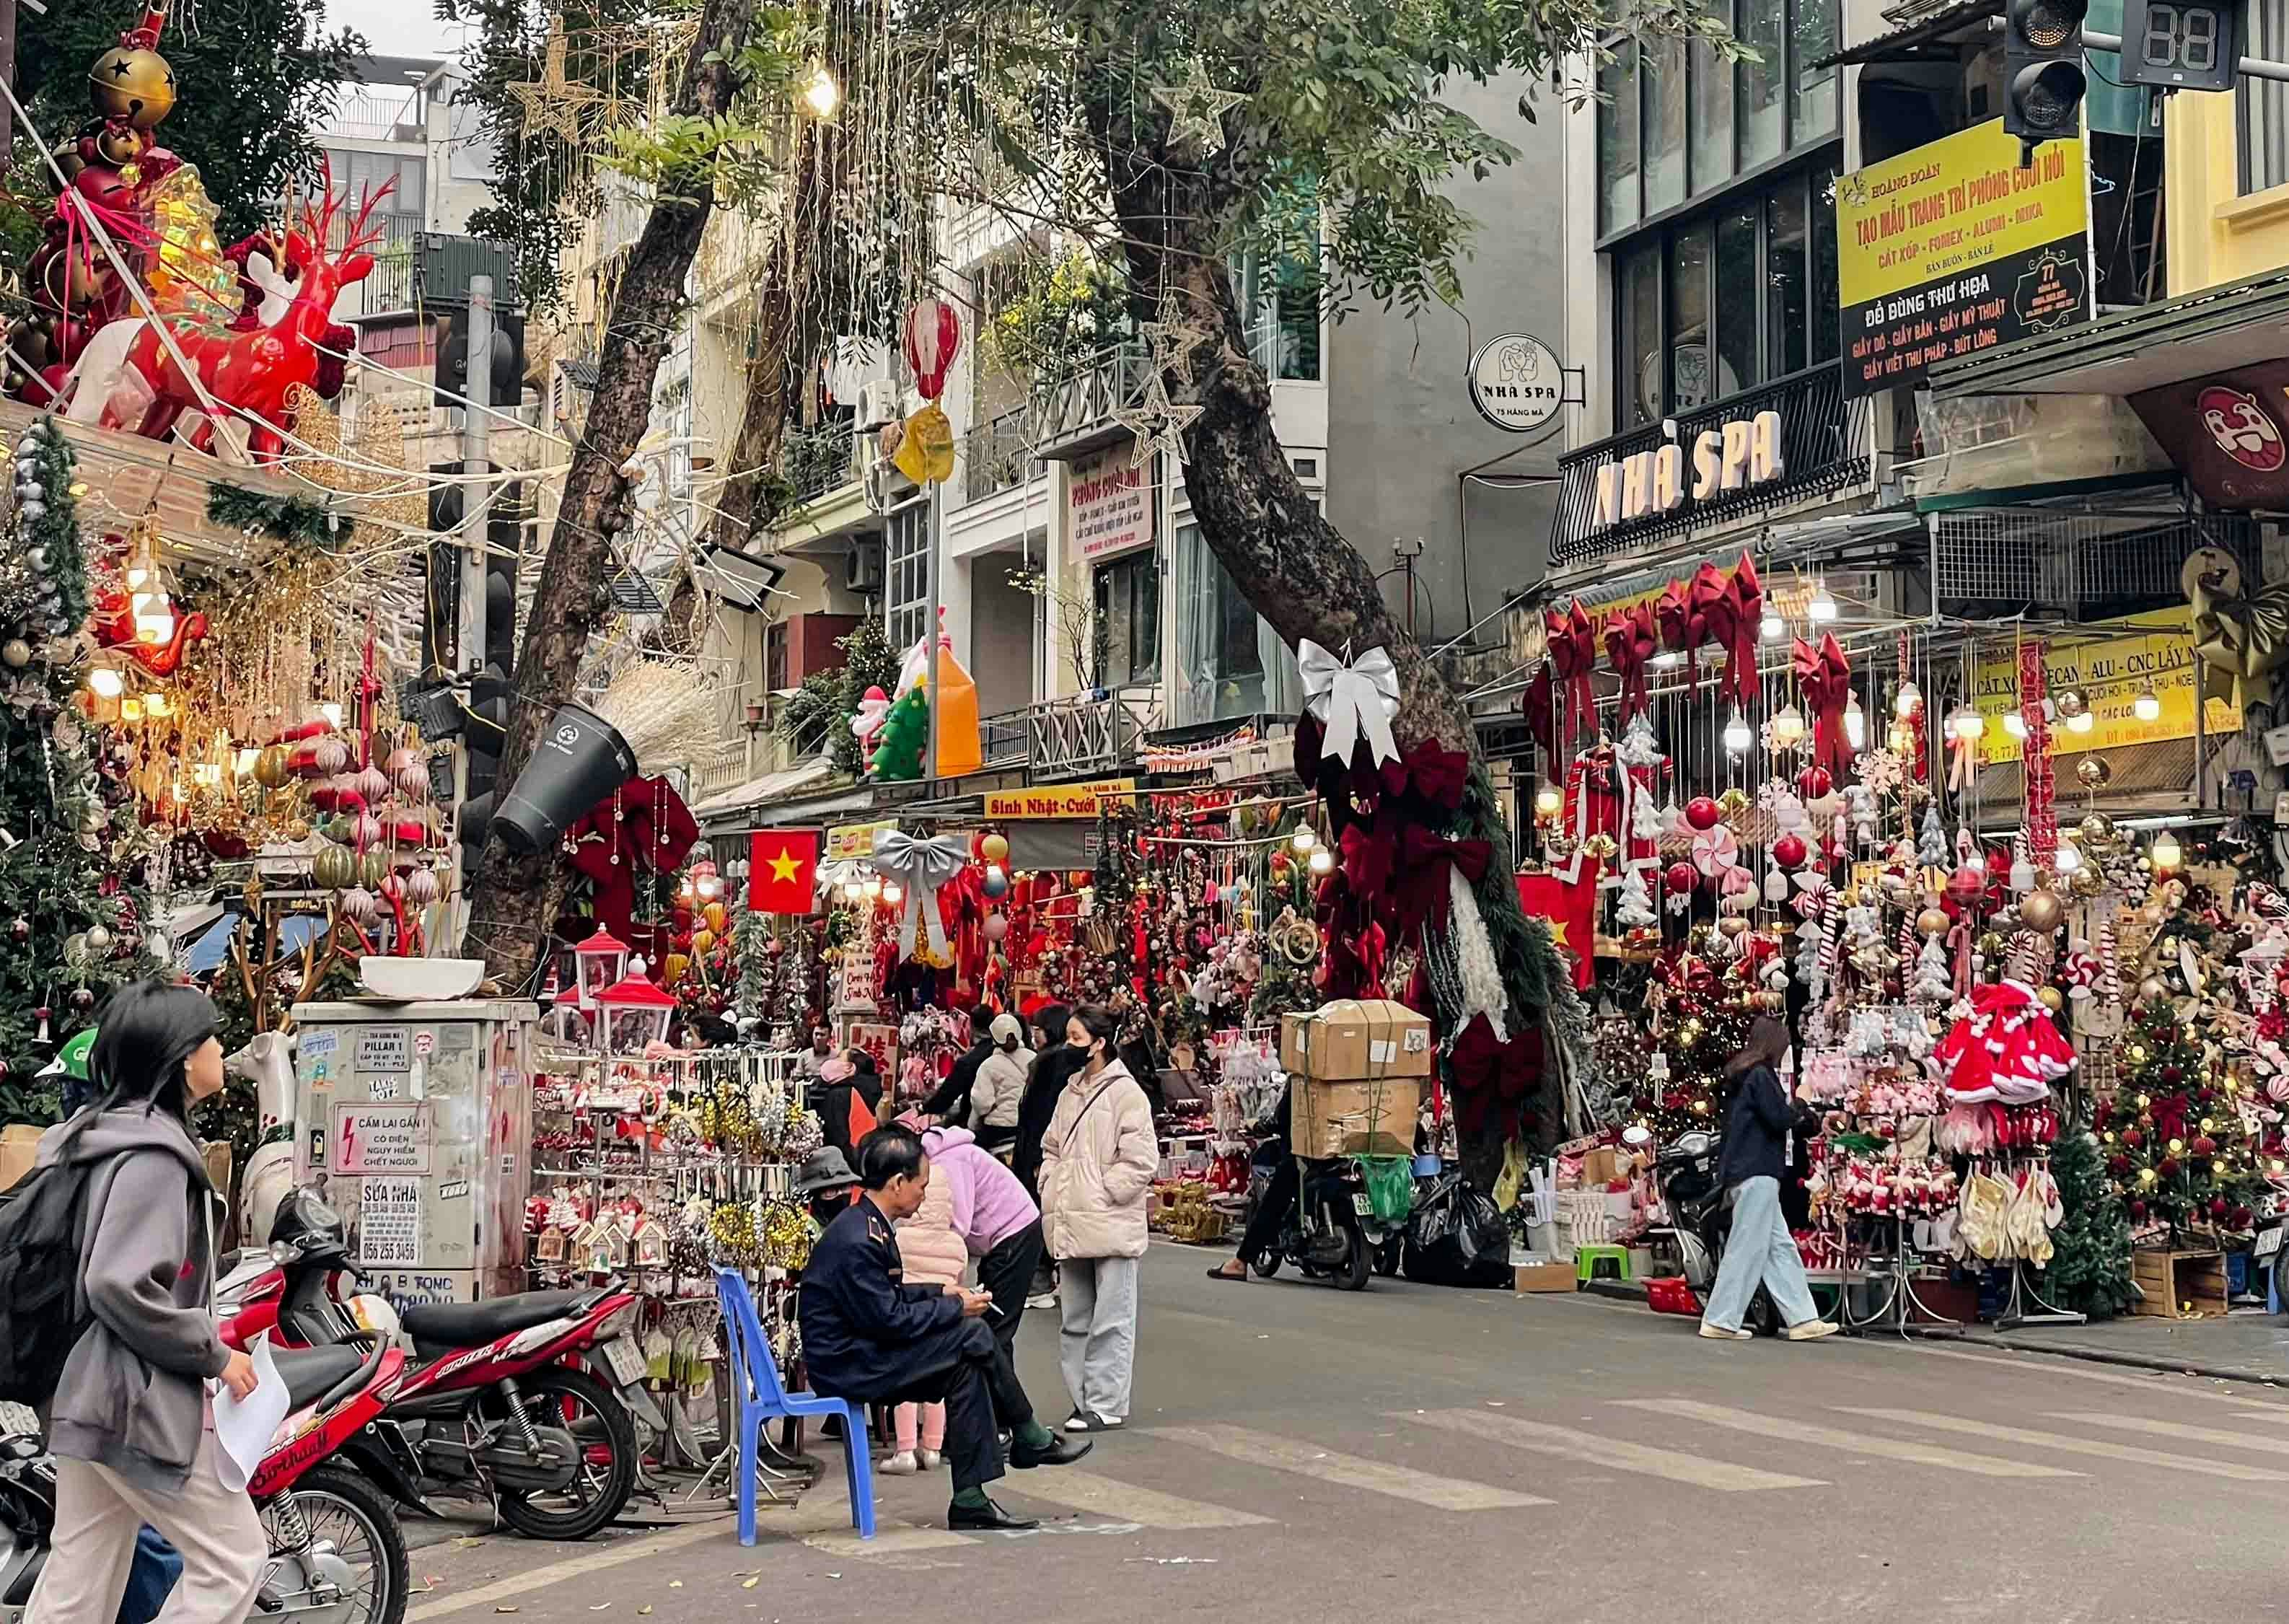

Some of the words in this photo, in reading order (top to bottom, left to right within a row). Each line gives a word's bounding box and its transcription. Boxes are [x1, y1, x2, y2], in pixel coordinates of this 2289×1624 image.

[1856, 215, 1877, 251] TẠO
[1880, 198, 1905, 239] MẪU
[1907, 191, 1946, 229] TRANG
[1948, 178, 1967, 215] TRÍ
[2042, 263, 2055, 282] 77
[1865, 300, 1885, 327] ĐỒ
[1928, 281, 1956, 308] THƯ
[1979, 298, 2006, 321] THUẬT
[1483, 382, 1519, 398] NHÀ
[1524, 387, 1555, 398] SPA
[1594, 418, 1684, 527] NHÀ
[1692, 411, 1783, 500] SPA
[2092, 659, 2115, 679] ALU
[2127, 653, 2154, 673] CNC
[2158, 641, 2184, 667] LẤY
[1027, 796, 1058, 817] Nhật
[1066, 796, 1096, 815] Cưới
[364, 1042, 395, 1051] PILLAR
[398, 1042, 402, 1051] 1
[359, 1116, 379, 1128] CẤM
[364, 1178, 388, 1202] SỬA
[380, 1242, 394, 1260] 255
[396, 1243, 415, 1260] 3456
